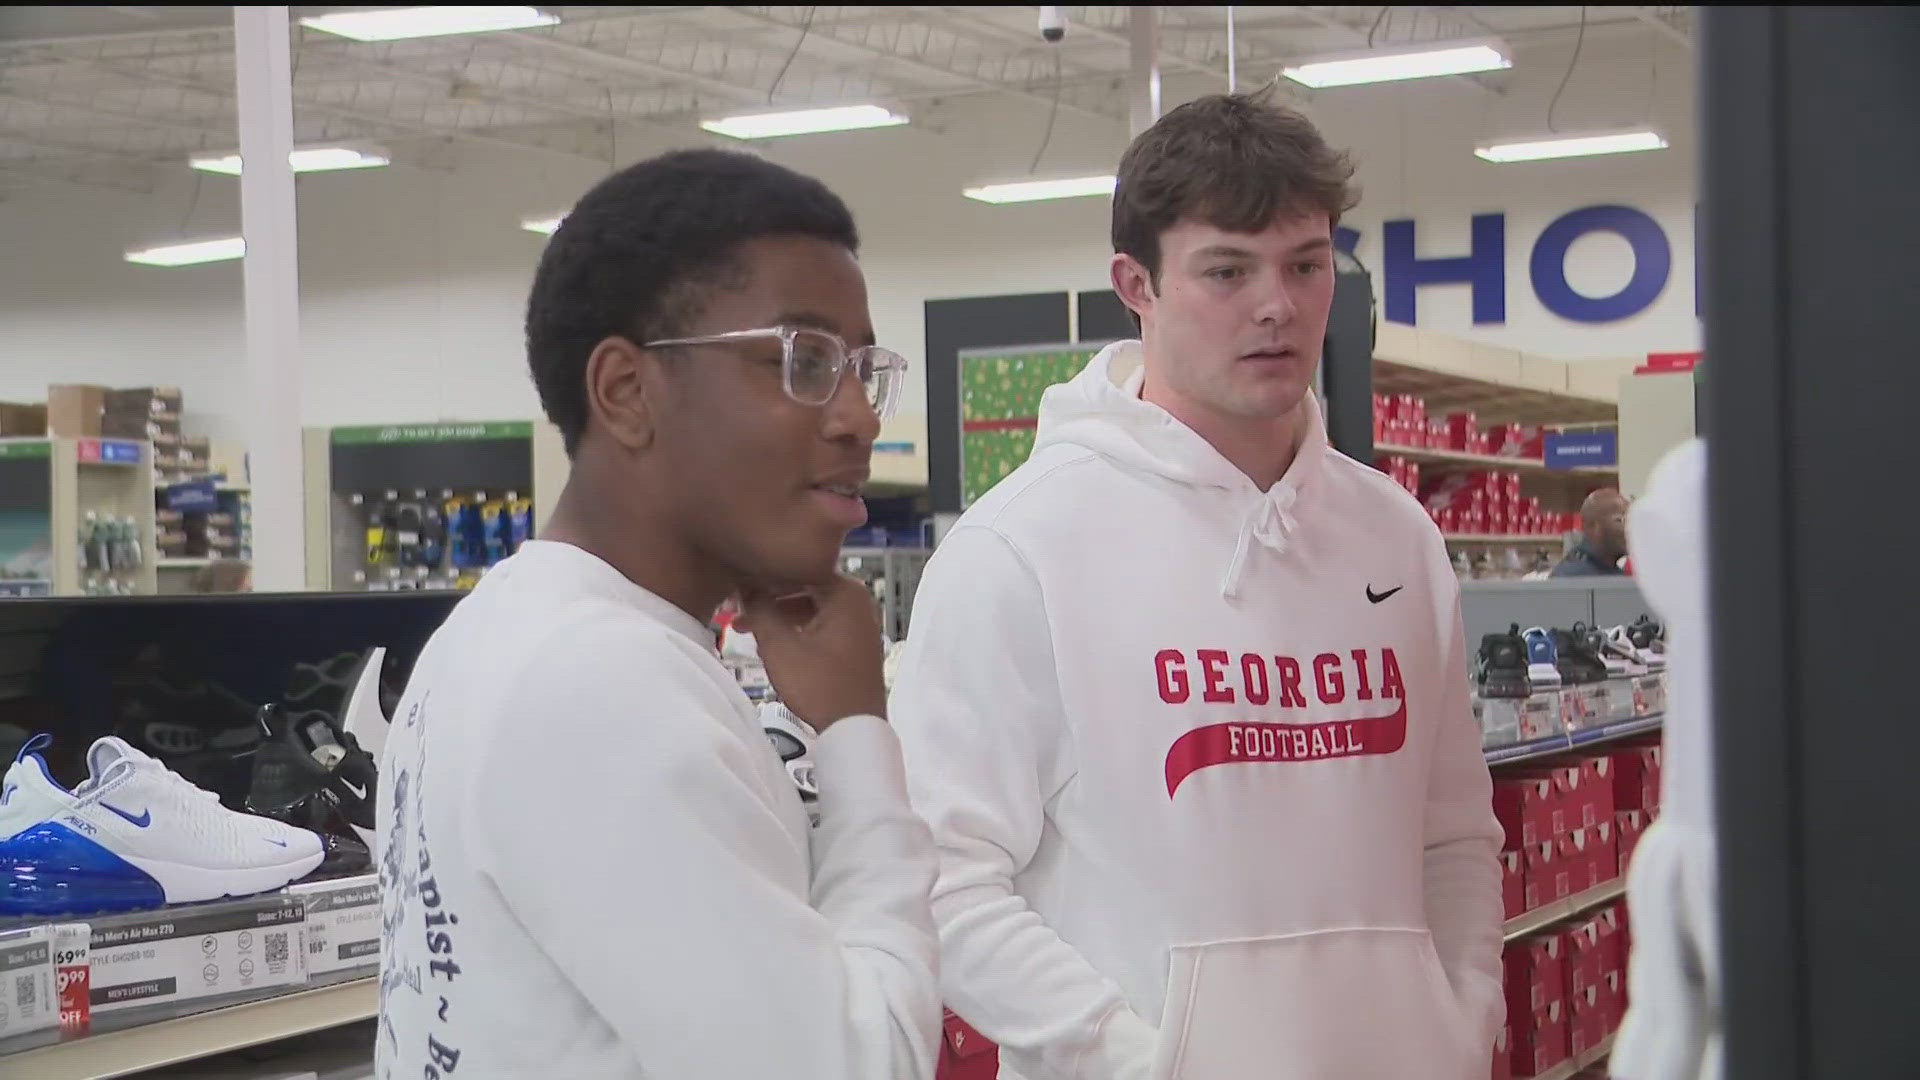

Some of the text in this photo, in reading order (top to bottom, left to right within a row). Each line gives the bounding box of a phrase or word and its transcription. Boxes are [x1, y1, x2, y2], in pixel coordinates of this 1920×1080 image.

[1335, 204, 1702, 327] HO
[1154, 647, 1405, 708] GEORGIA
[1228, 724, 1364, 759] FOOTBALL
[105, 930, 130, 943] Men's
[130, 927, 142, 939] Air
[142, 926, 158, 937] Max
[159, 924, 175, 935] 270
[128, 983, 159, 996] LIFESTYLE
[60, 1010, 82, 1024] OFF
